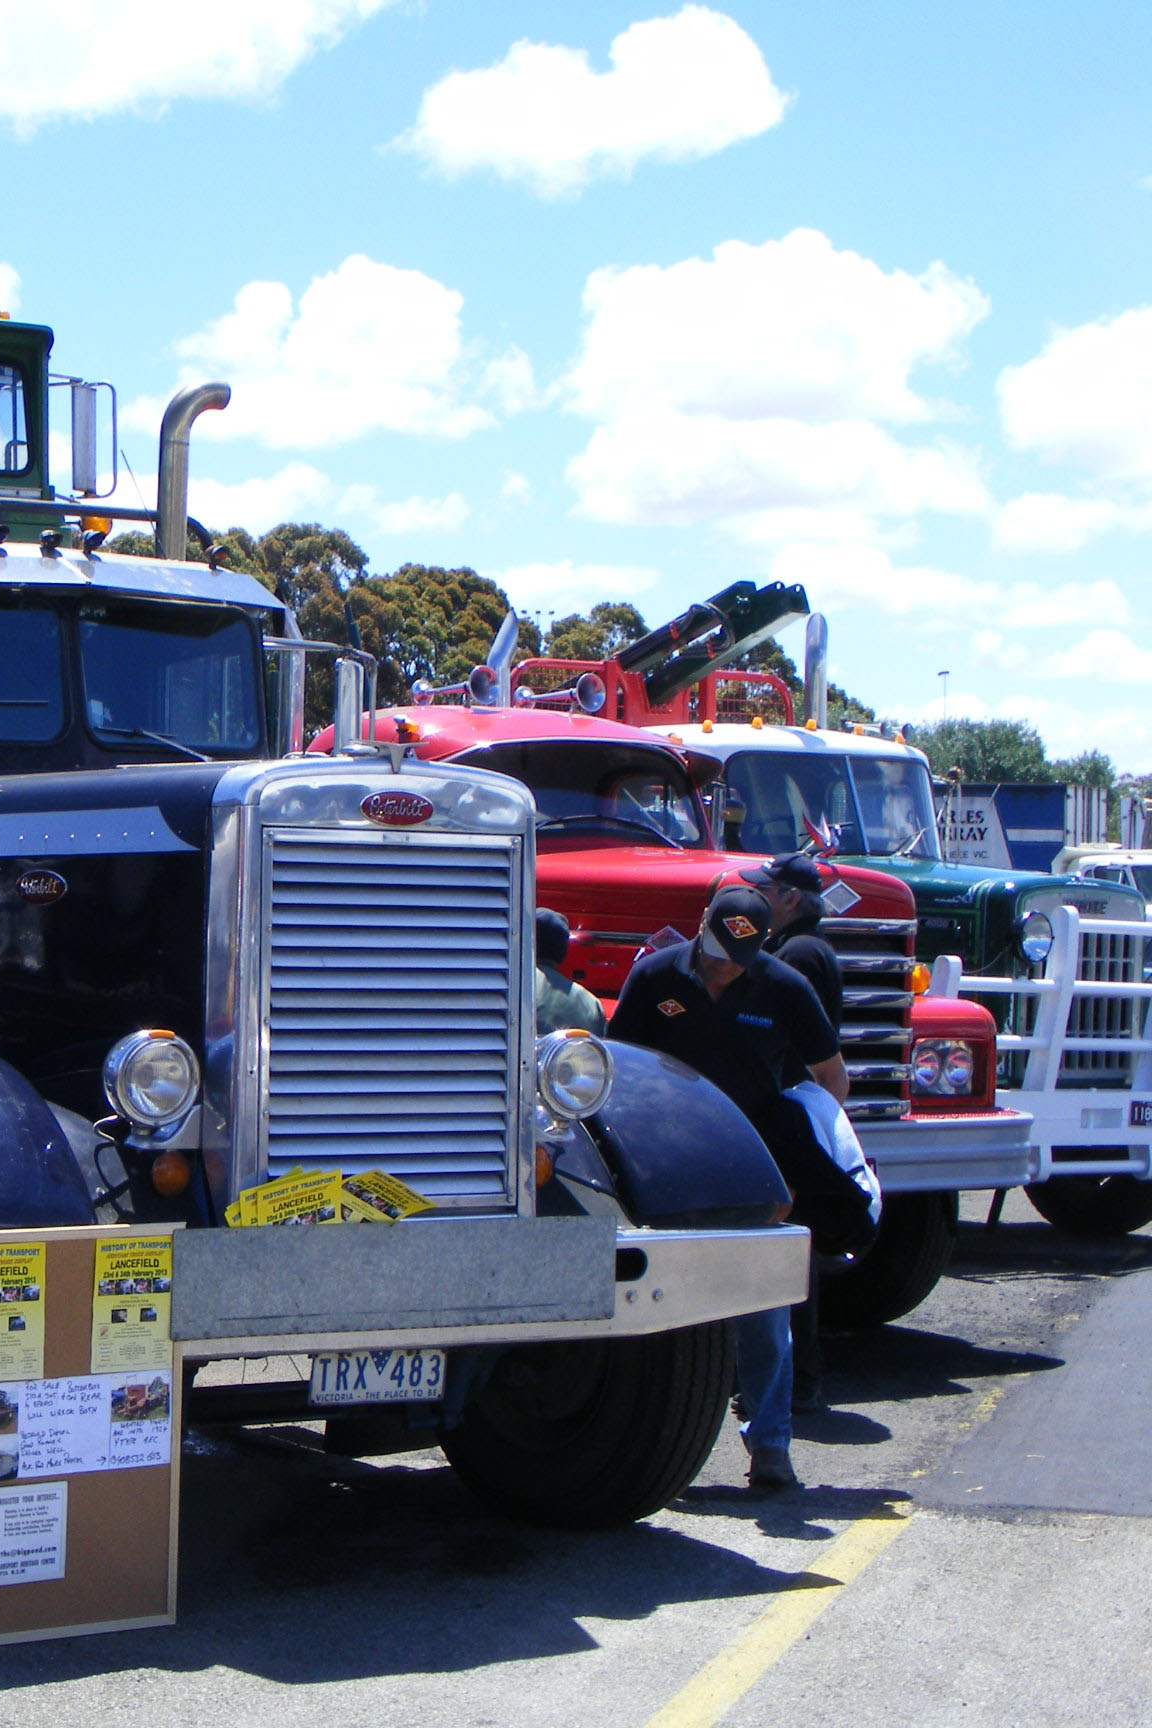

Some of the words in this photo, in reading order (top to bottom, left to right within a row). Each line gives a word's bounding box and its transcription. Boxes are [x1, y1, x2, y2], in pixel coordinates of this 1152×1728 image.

[369, 795, 429, 816] Peterbilt
[263, 1187, 289, 1200] HISTORY
[290, 1184, 299, 1192] OF
[300, 1176, 336, 1188] TRANSPORT
[272, 1192, 324, 1213] LANCEFIELD
[6, 1248, 40, 1256] TRANSPORT
[101, 1244, 127, 1252] HISTORY
[128, 1242, 136, 1250] OF
[138, 1241, 172, 1249] TRANSPORT
[110, 1258, 160, 1270] LANCEFIELD
[132, 1270, 154, 1278] February
[1, 1278, 23, 1286] February
[319, 1356, 369, 1392] TRX
[390, 1354, 441, 1388] 483
[42, 1381, 60, 1390] SALE
[316, 1393, 354, 1402] VICTORIA
[365, 1392, 381, 1400] THE
[384, 1390, 408, 1398] PLACE
[413, 1388, 424, 1398] TO
[428, 1388, 438, 1397] BE
[50, 1408, 74, 1416] WRECK
